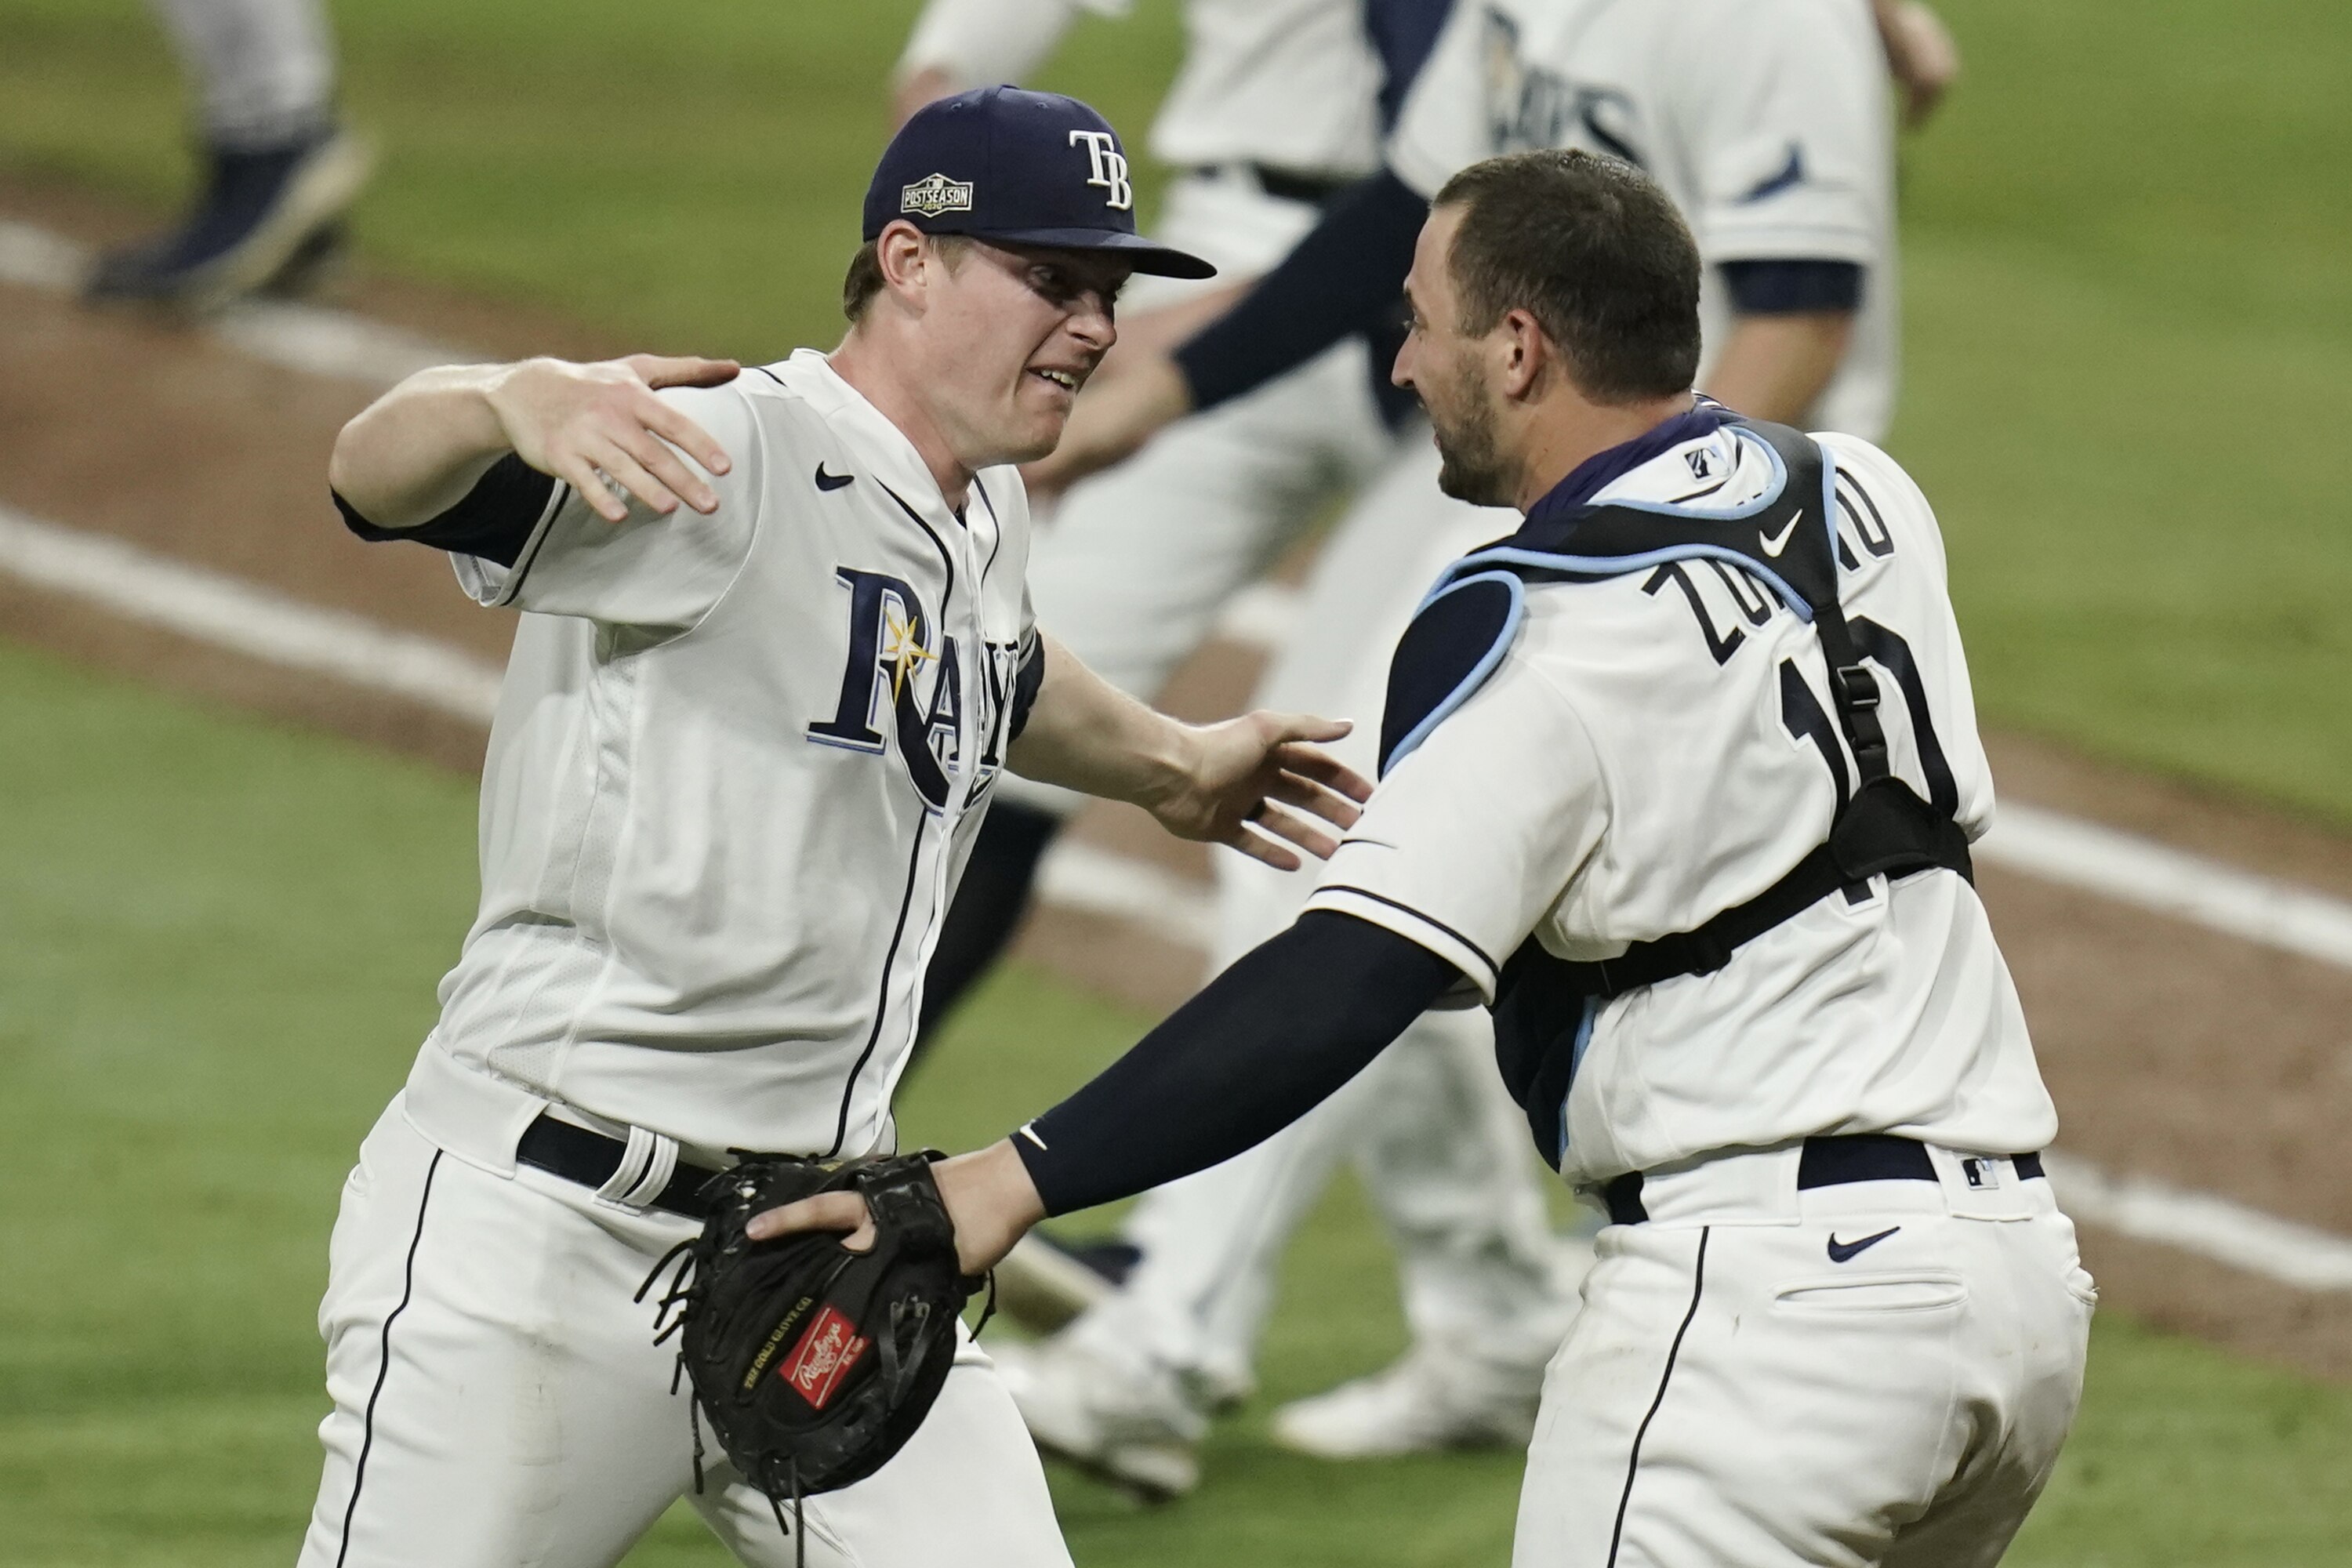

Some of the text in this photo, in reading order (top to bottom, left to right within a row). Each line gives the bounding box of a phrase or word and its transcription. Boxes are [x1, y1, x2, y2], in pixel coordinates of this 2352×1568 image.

[905, 187, 967, 206] POSTSEASON
[1069, 129, 1132, 211] TB
[744, 1367, 759, 1389] THE
[753, 1341, 777, 1370] GOLD
[771, 1309, 800, 1342] GLOVE
[798, 1323, 841, 1390] Rawlings
